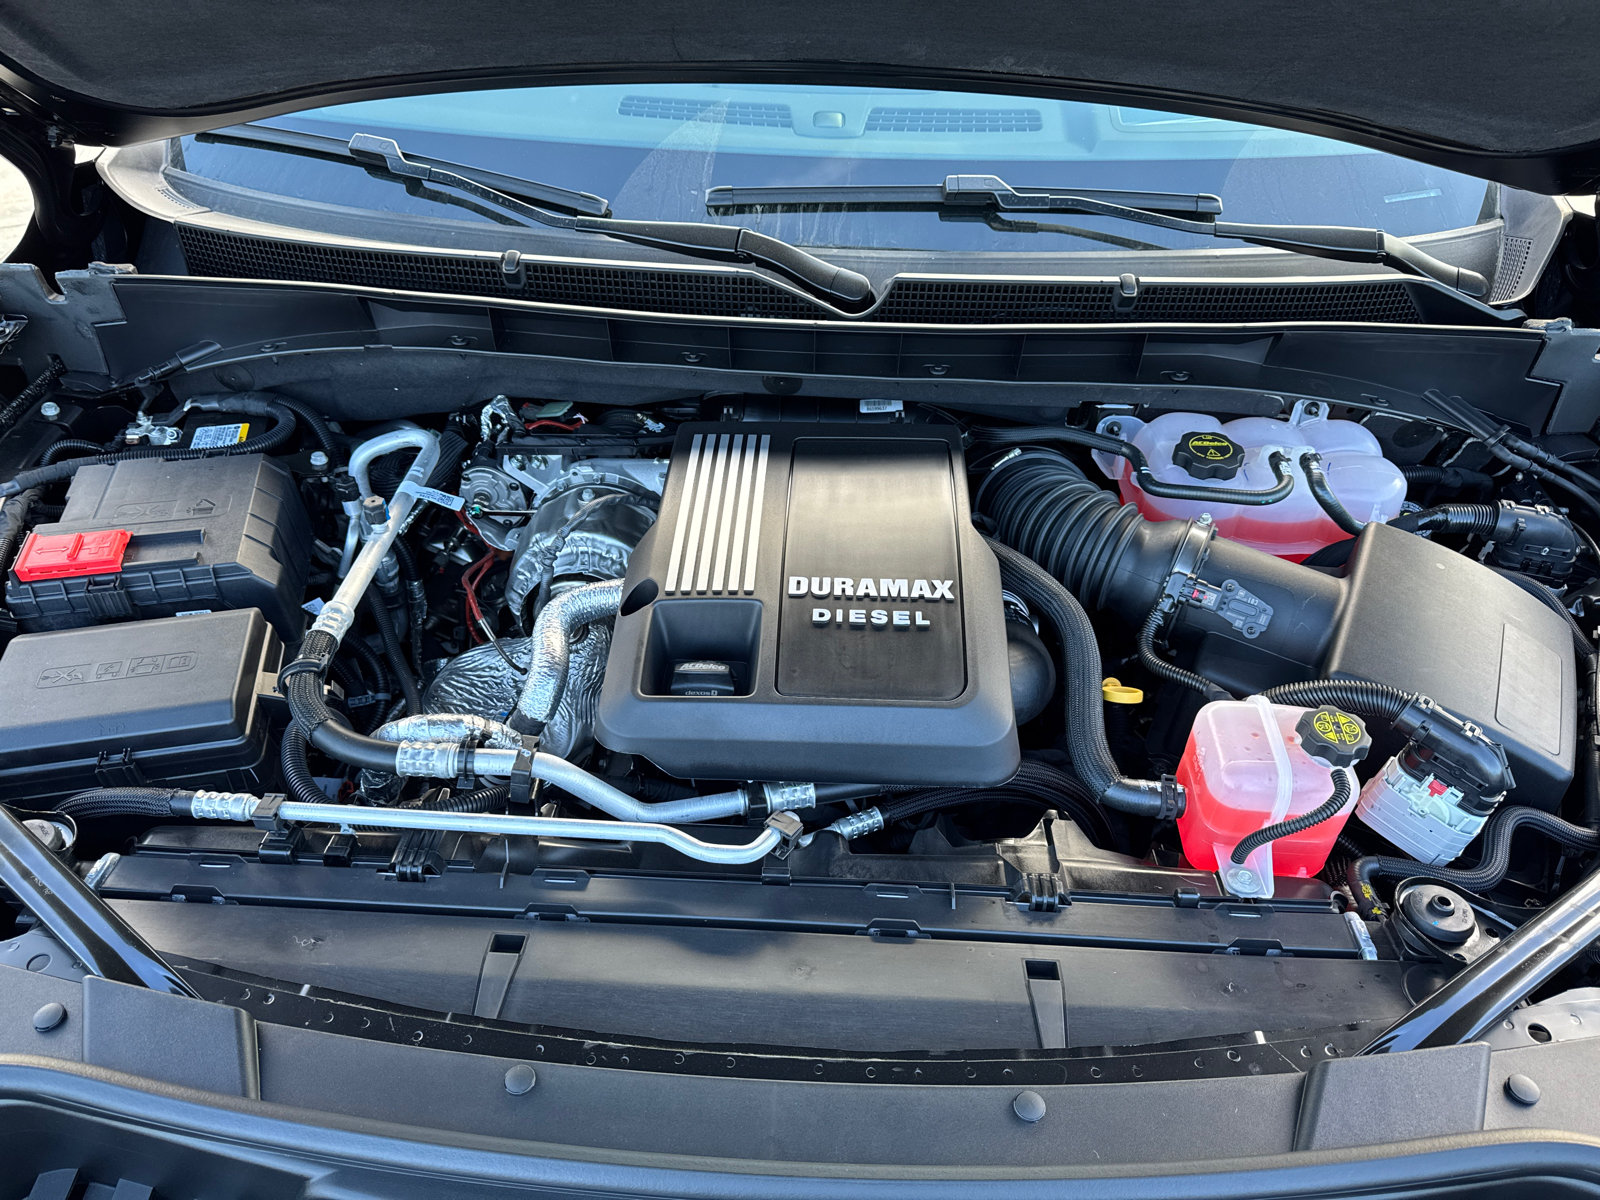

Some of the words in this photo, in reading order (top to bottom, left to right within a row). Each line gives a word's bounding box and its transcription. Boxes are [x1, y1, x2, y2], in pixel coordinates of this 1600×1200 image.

[787, 576, 955, 600] DURAMAX
[812, 608, 931, 627] DIESEL
[679, 663, 726, 671] ACDelco
